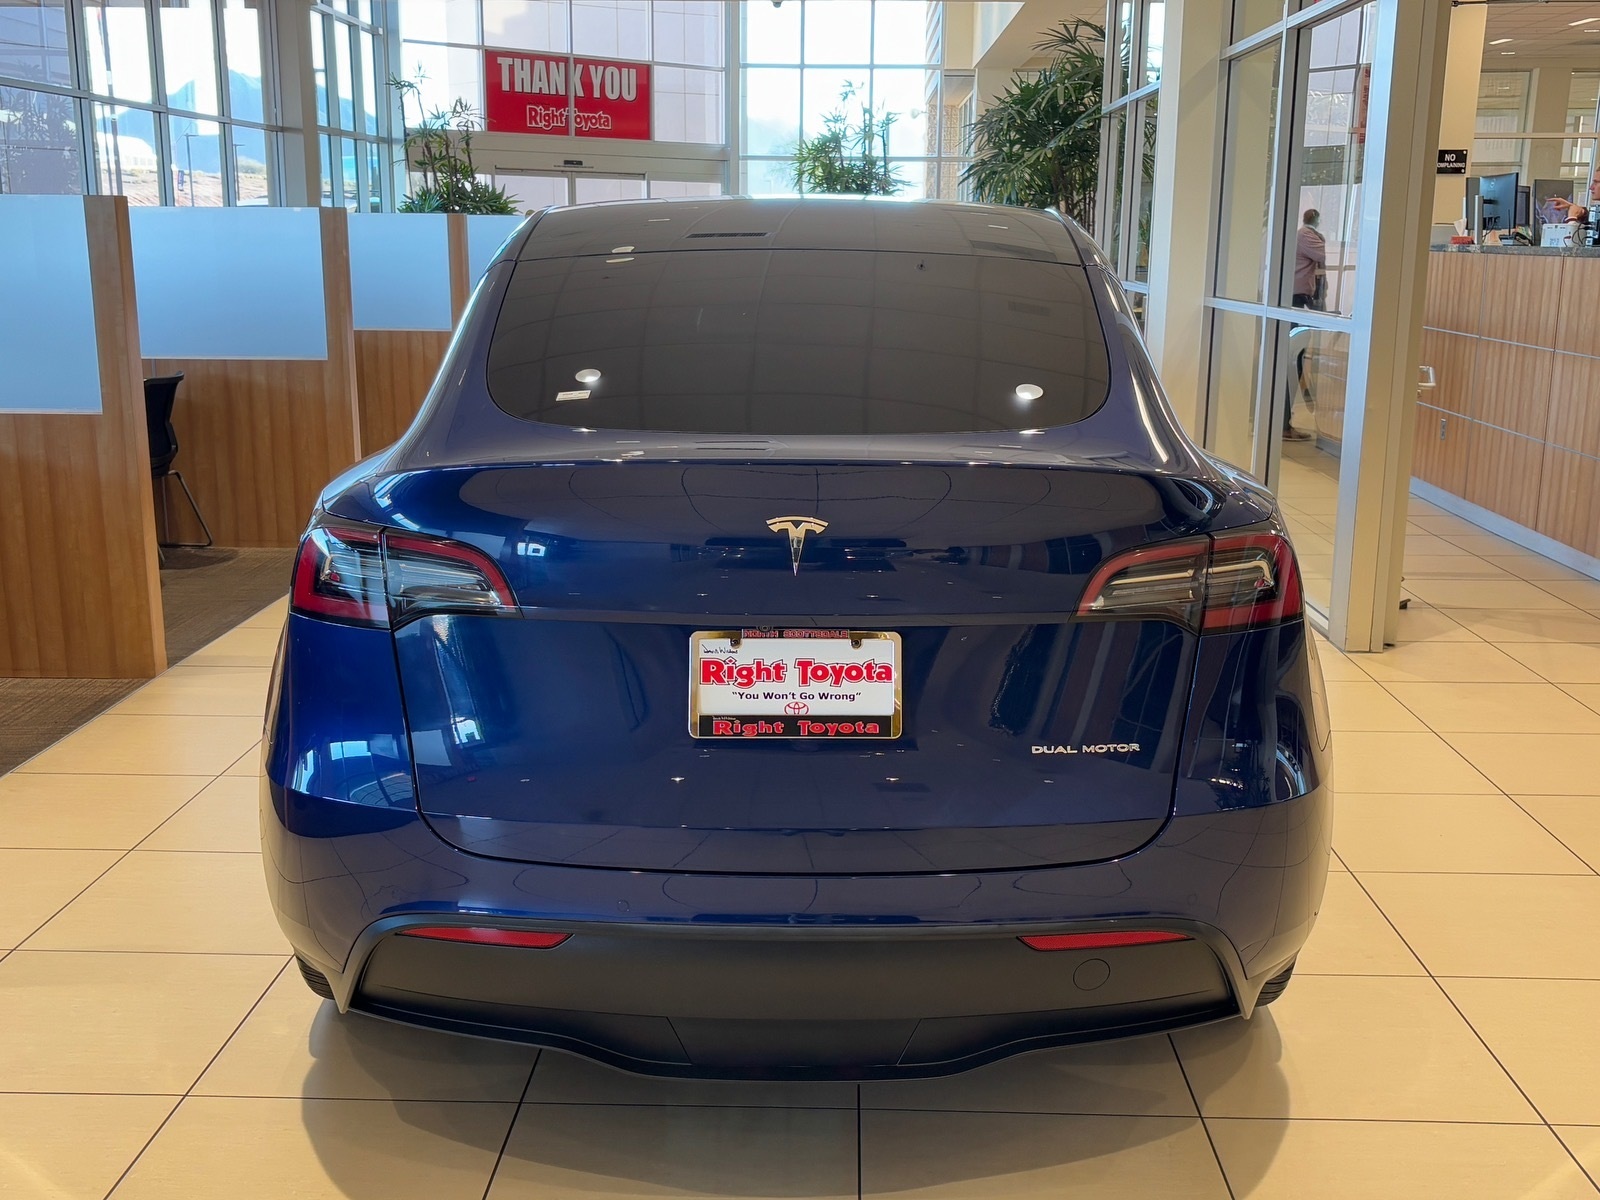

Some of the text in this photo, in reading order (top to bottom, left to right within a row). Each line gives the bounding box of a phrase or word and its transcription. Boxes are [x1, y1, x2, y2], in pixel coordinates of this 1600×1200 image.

[497, 57, 637, 101] THANK YOU
[527, 105, 565, 130] Right
[700, 656, 892, 689] Right Toyota
[763, 692, 796, 700] Won't
[800, 692, 815, 700] Go
[713, 720, 879, 737] Right Toyota
[1082, 744, 1140, 753] MOTOR
